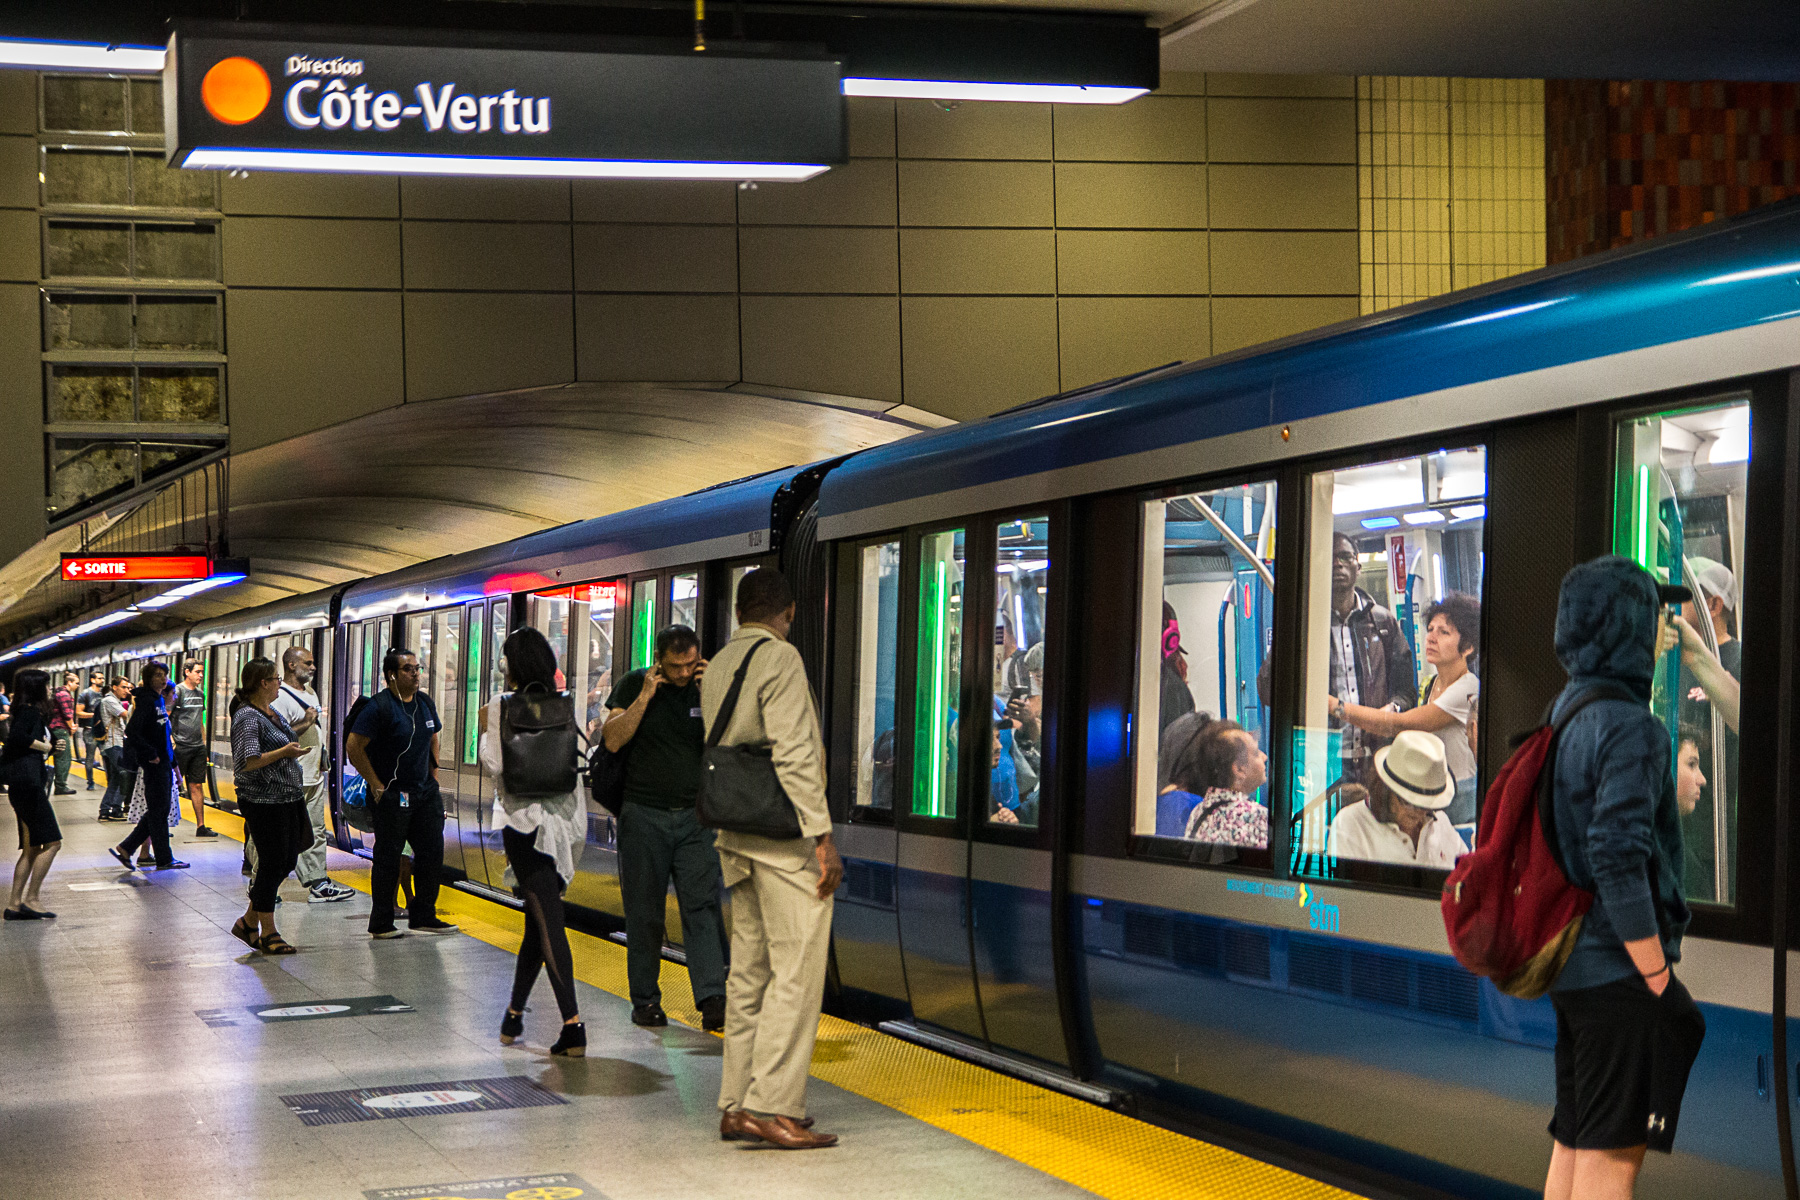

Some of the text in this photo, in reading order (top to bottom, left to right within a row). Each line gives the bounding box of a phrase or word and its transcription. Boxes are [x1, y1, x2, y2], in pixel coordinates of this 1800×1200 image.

[285, 55, 362, 75] Direction
[285, 79, 550, 133] Côte-Vertu
[85, 563, 126, 574] SORTIE
[1264, 883, 1296, 899] COLLECTIF
[1309, 897, 1339, 933] stm
